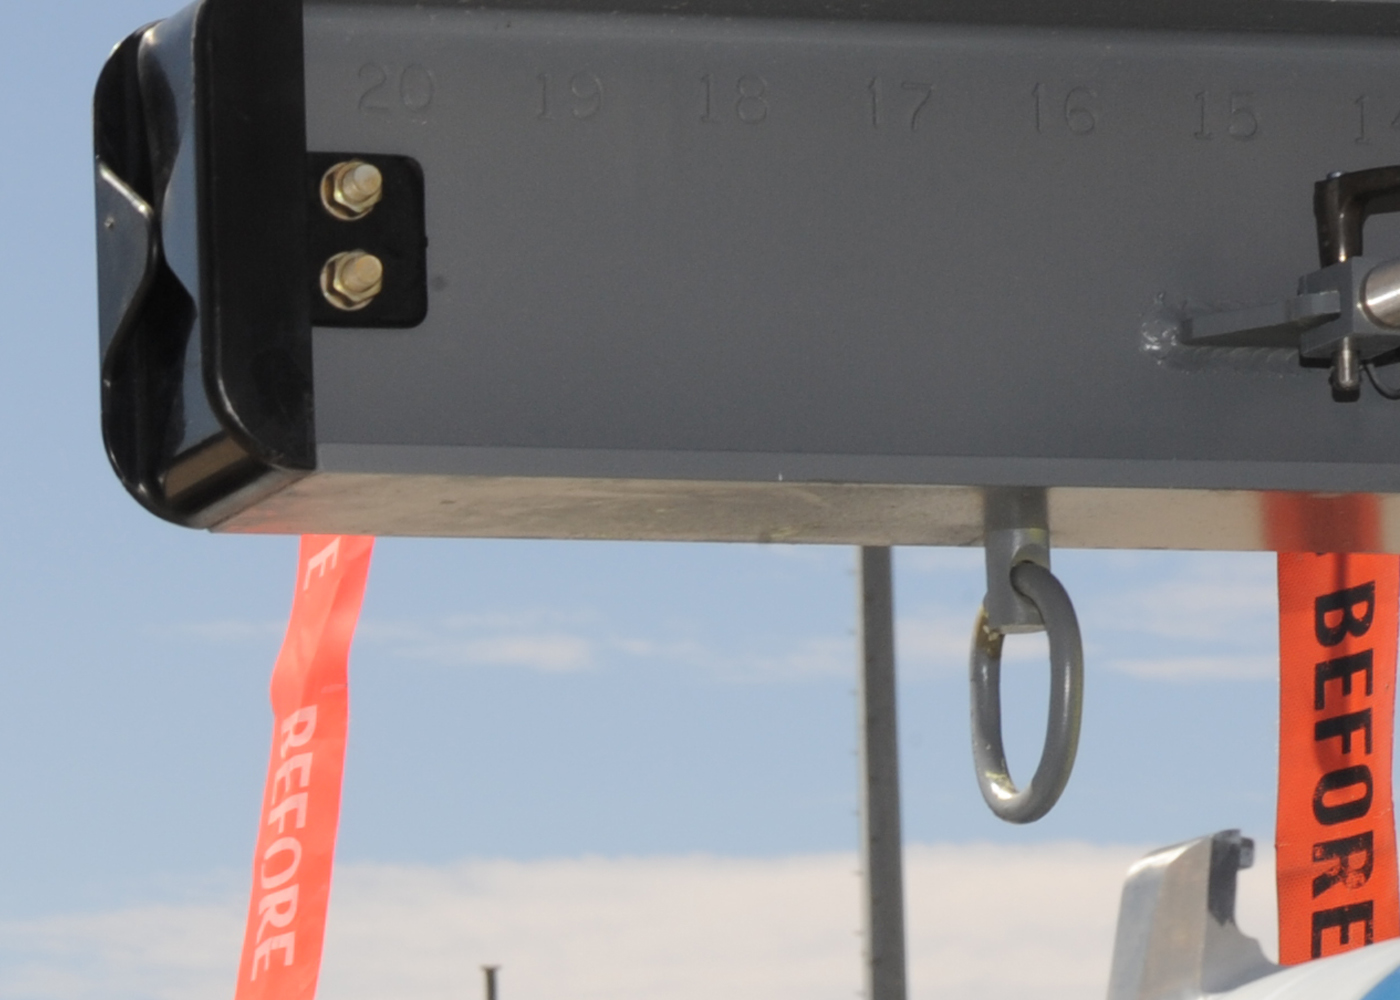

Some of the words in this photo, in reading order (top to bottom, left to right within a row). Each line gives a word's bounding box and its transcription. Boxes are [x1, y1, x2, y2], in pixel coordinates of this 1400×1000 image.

[357, 62, 434, 113] 20
[537, 72, 601, 121] 19
[700, 74, 768, 124] 18
[868, 76, 933, 131] 17
[1032, 81, 1096, 135] 16
[1194, 90, 1258, 140] 15
[1311, 579, 1376, 959] BEFORE
